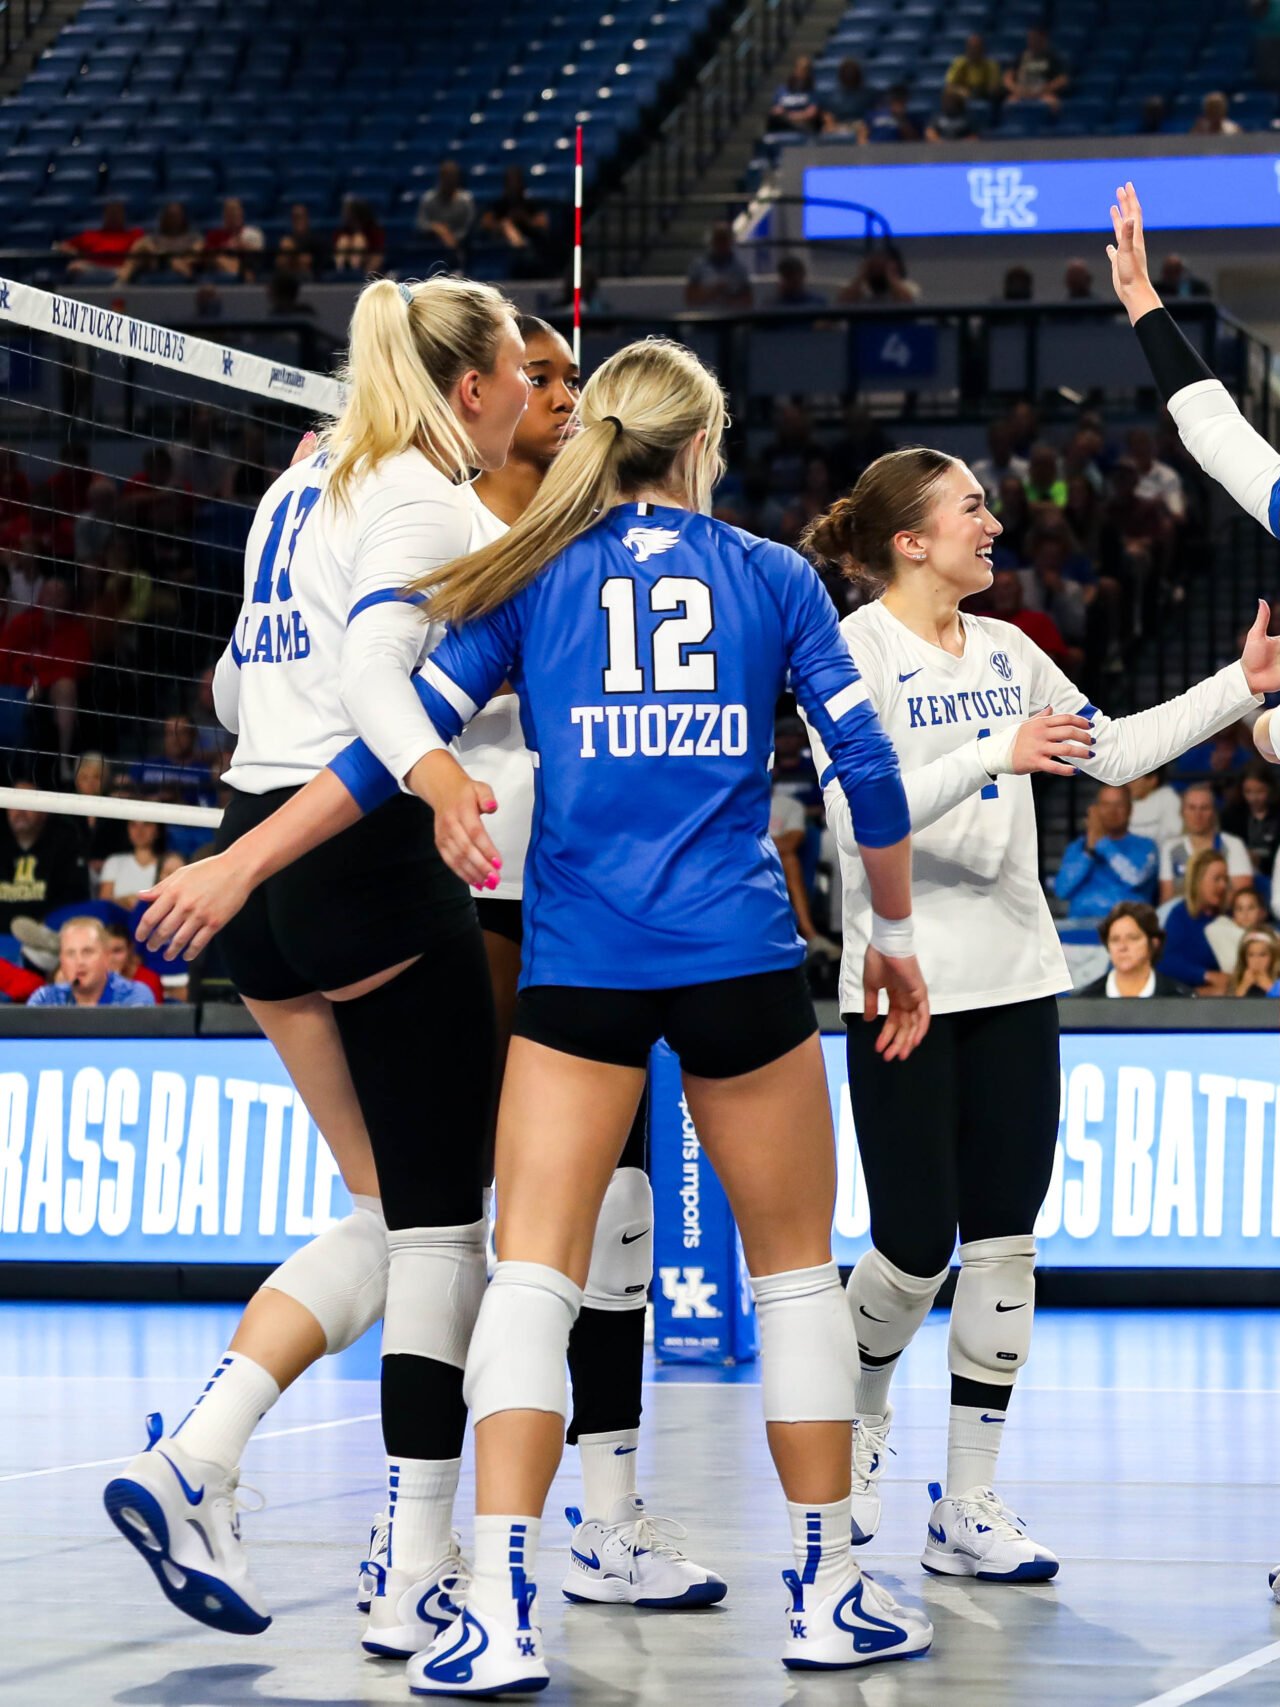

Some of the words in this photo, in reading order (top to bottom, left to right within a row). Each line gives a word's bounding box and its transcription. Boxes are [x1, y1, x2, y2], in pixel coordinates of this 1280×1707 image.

[967, 168, 1038, 228] UK
[52, 296, 124, 344] KENTUCKY
[128, 320, 185, 362] WILDCATS
[882, 332, 910, 367] 4
[241, 610, 311, 663] LAMB
[600, 575, 718, 694] 12
[571, 704, 748, 758] TUOZZO
[907, 685, 1023, 728] KENTUCKY
[678, 1091, 701, 1160] ports
[680, 1162, 702, 1248] imports
[659, 1267, 718, 1318] UK
[515, 1637, 536, 1657] UK
[790, 1619, 807, 1638] UK
